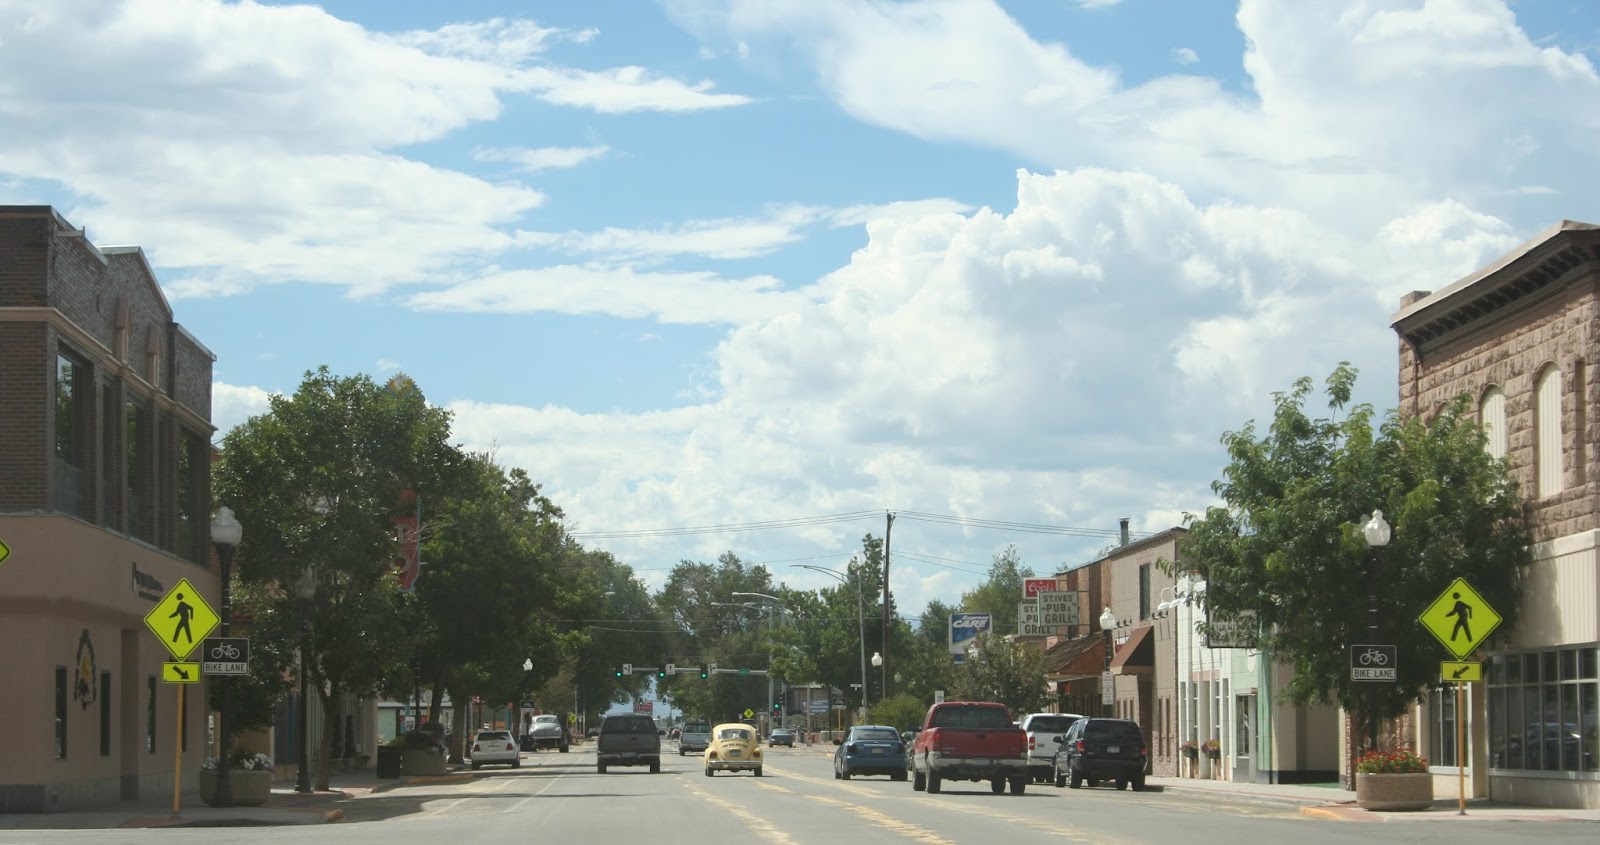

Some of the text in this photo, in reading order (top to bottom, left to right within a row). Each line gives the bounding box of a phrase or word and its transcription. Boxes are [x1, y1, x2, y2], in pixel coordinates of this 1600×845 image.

[1046, 603, 1066, 612] PUB
[1026, 614, 1038, 622] PU
[1045, 614, 1073, 623] GRILL
[952, 619, 988, 629] CARE
[1025, 625, 1051, 634] GRILL
[205, 663, 246, 672] BIKE LANE
[1354, 669, 1394, 678] BIKE LANE
